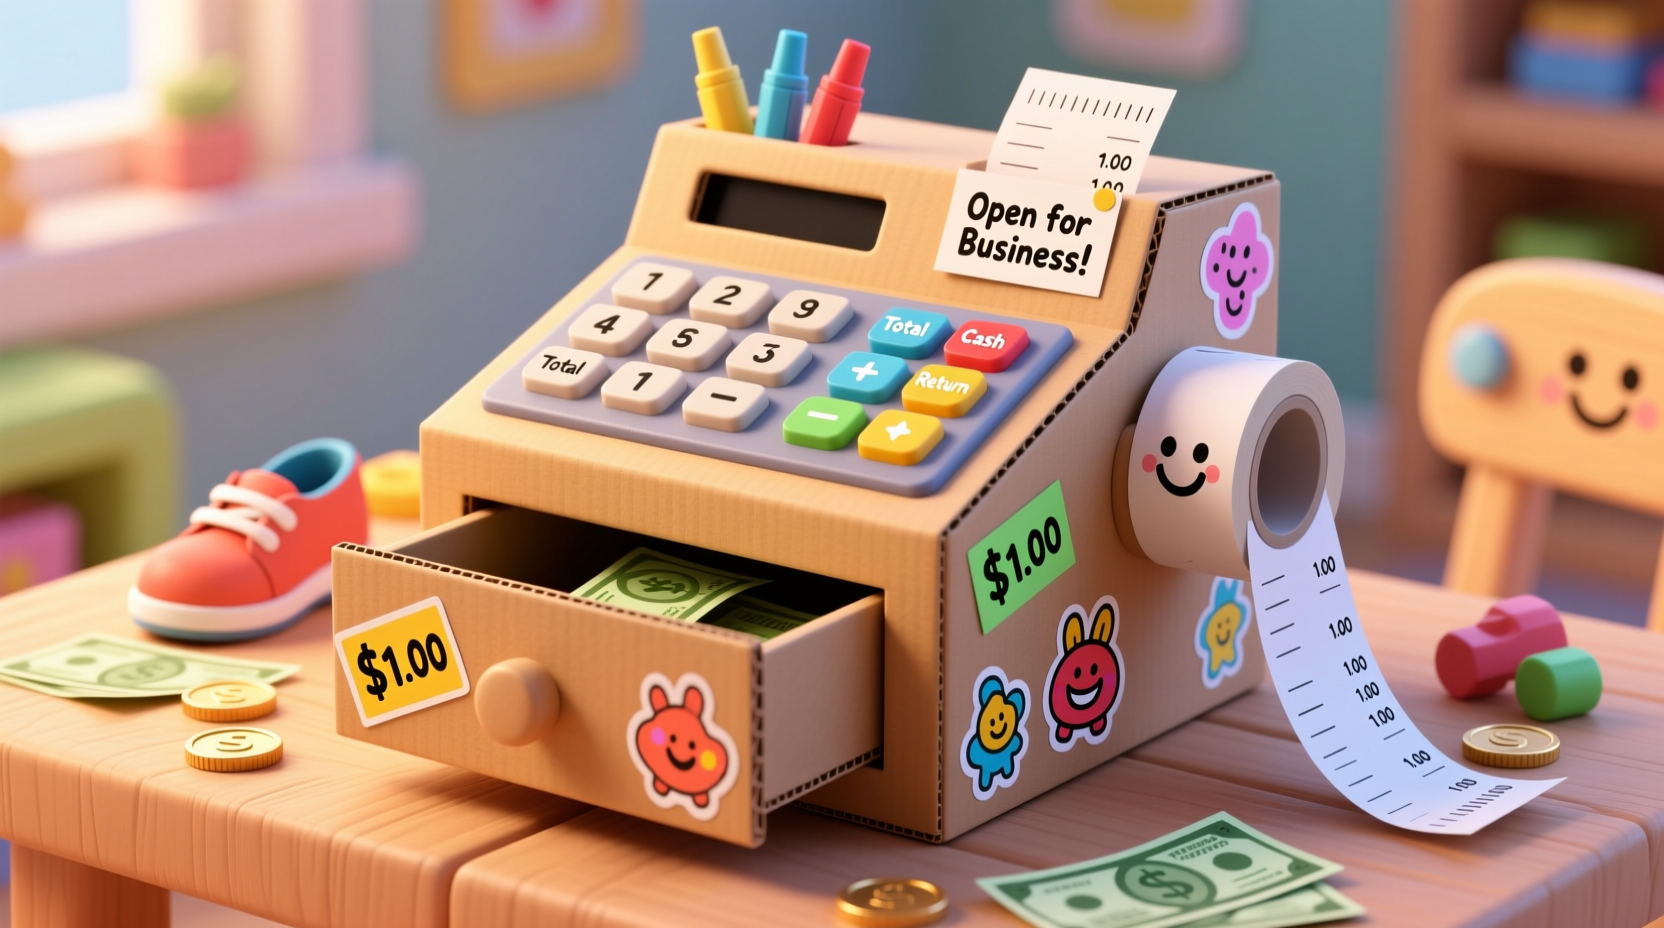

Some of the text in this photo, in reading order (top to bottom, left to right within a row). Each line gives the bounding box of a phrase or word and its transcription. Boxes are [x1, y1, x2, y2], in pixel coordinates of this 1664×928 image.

[1098, 152, 1132, 172] 1.00
[966, 191, 1093, 237] Open for
[957, 226, 1093, 276] Business!
[643, 272, 663, 291] 1
[713, 285, 742, 306] 2
[793, 299, 820, 319] 9
[593, 314, 621, 335] 4
[884, 315, 931, 337] Total
[671, 328, 699, 348] 5
[960, 328, 1006, 350] Cash
[752, 343, 780, 363] 3
[541, 354, 587, 375] Total
[632, 372, 653, 391] 1
[914, 371, 970, 395] Return
[982, 516, 1062, 606] $1.00
[1312, 555, 1336, 578] 1.00
[1328, 616, 1353, 639] 1.00
[357, 633, 448, 702] $1.00
[1343, 655, 1368, 677] 1.00
[1355, 681, 1380, 703] 1.00
[1368, 706, 1395, 728] 1.00
[1403, 750, 1431, 768] 1.00
